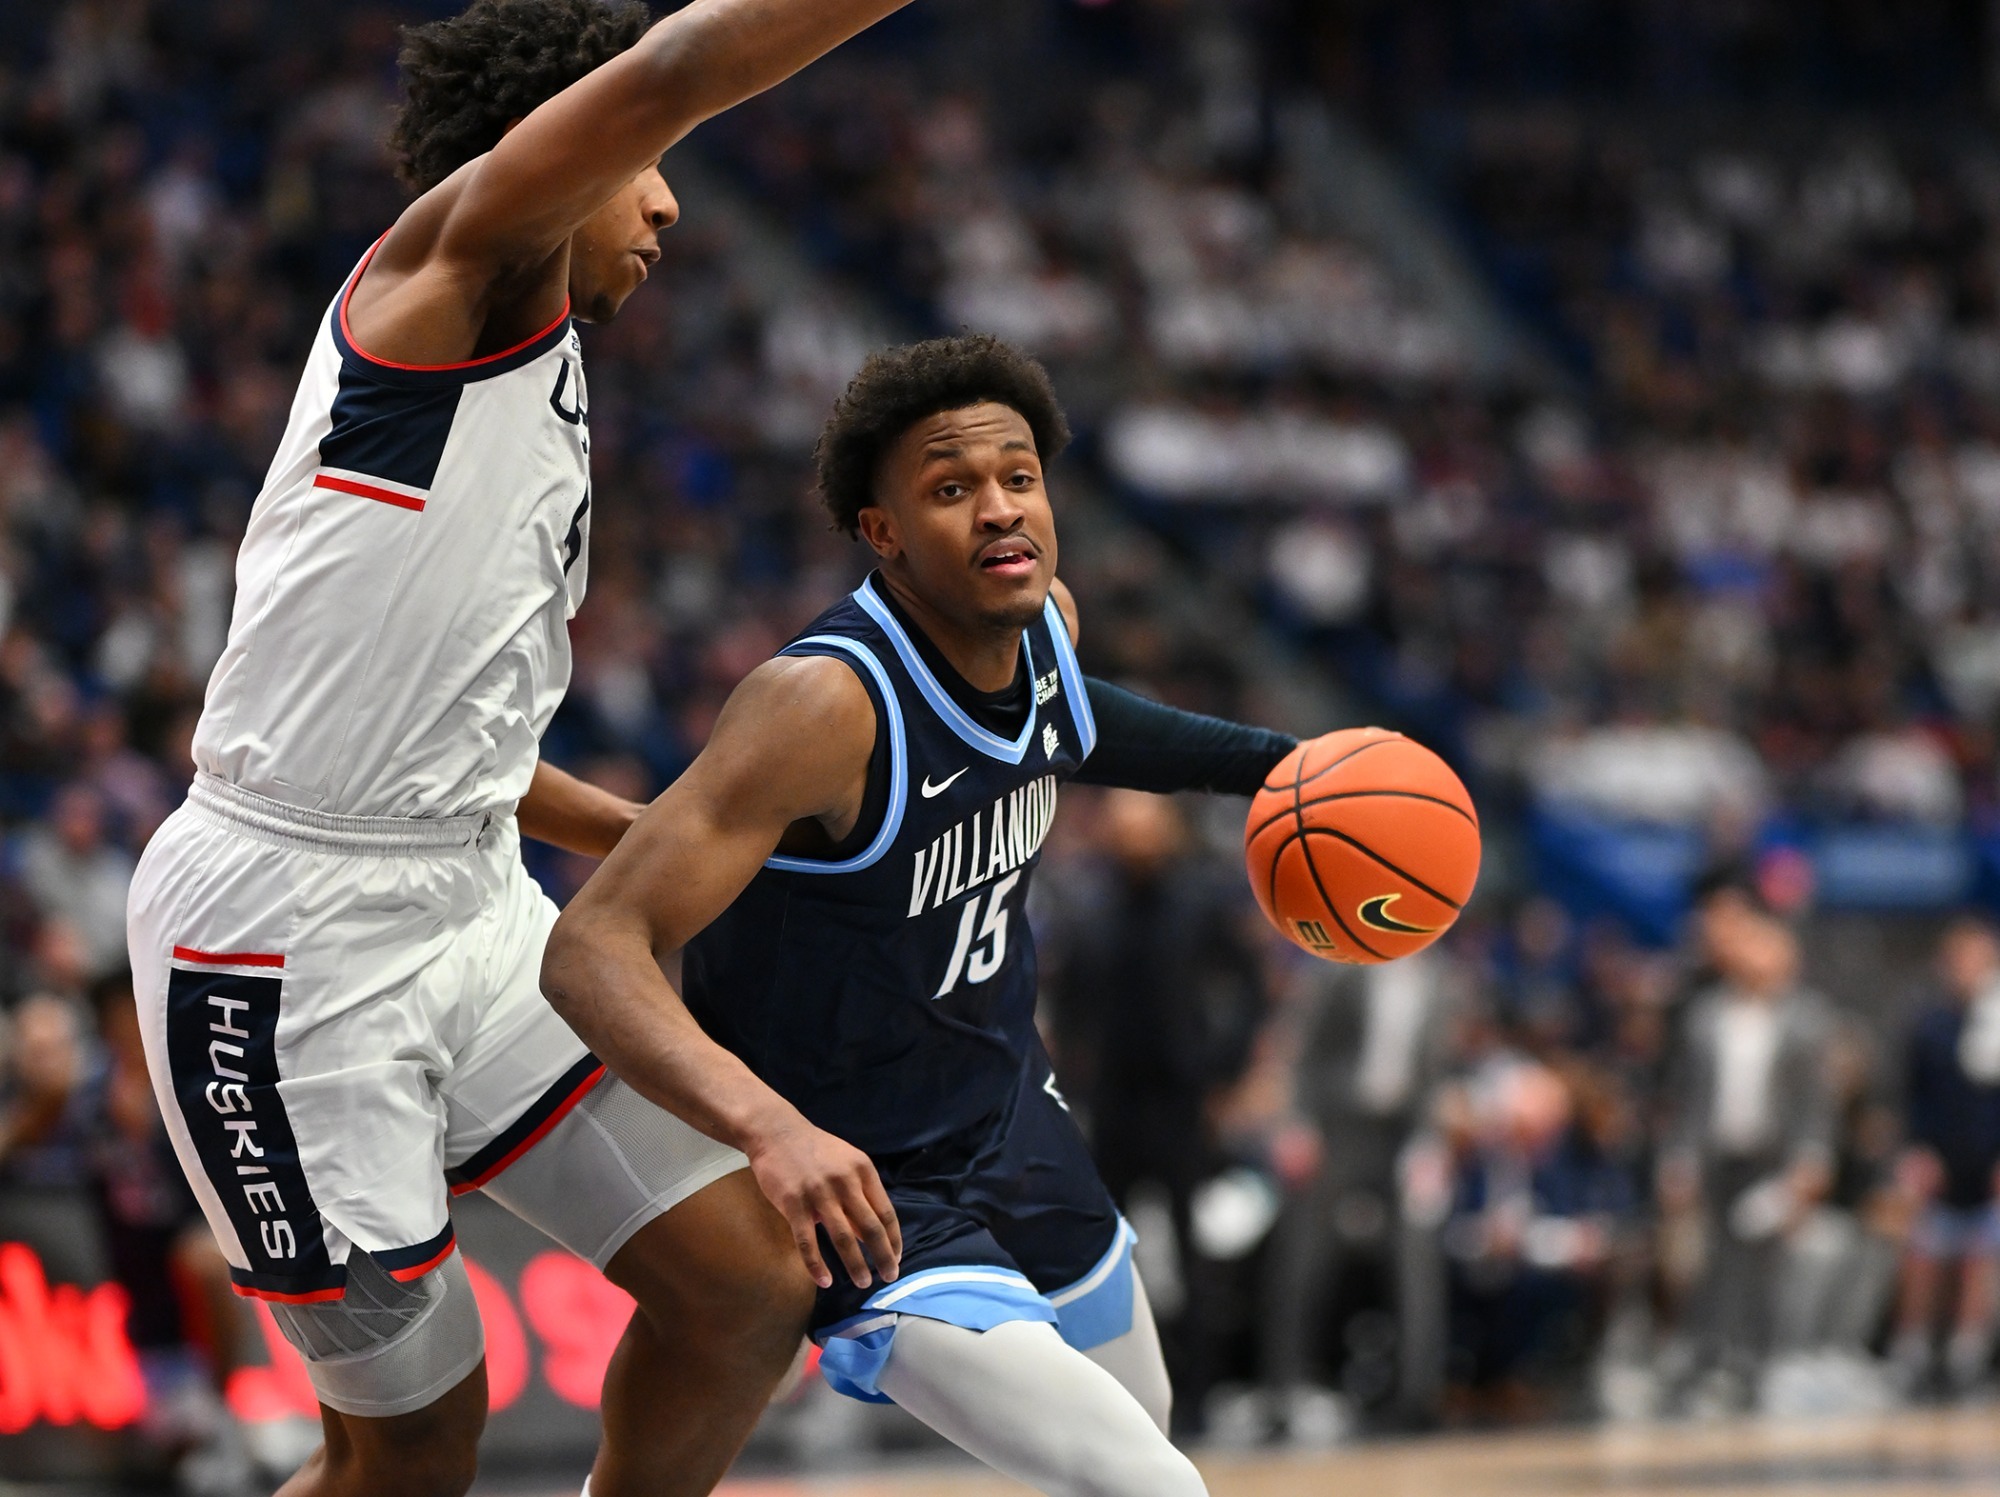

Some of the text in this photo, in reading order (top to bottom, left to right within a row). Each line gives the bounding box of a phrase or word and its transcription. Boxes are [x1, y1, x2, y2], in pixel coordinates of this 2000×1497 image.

[1035, 676, 1049, 693] BE
[931, 869, 1021, 1000] 15
[205, 995, 296, 1260] HUSKIES
